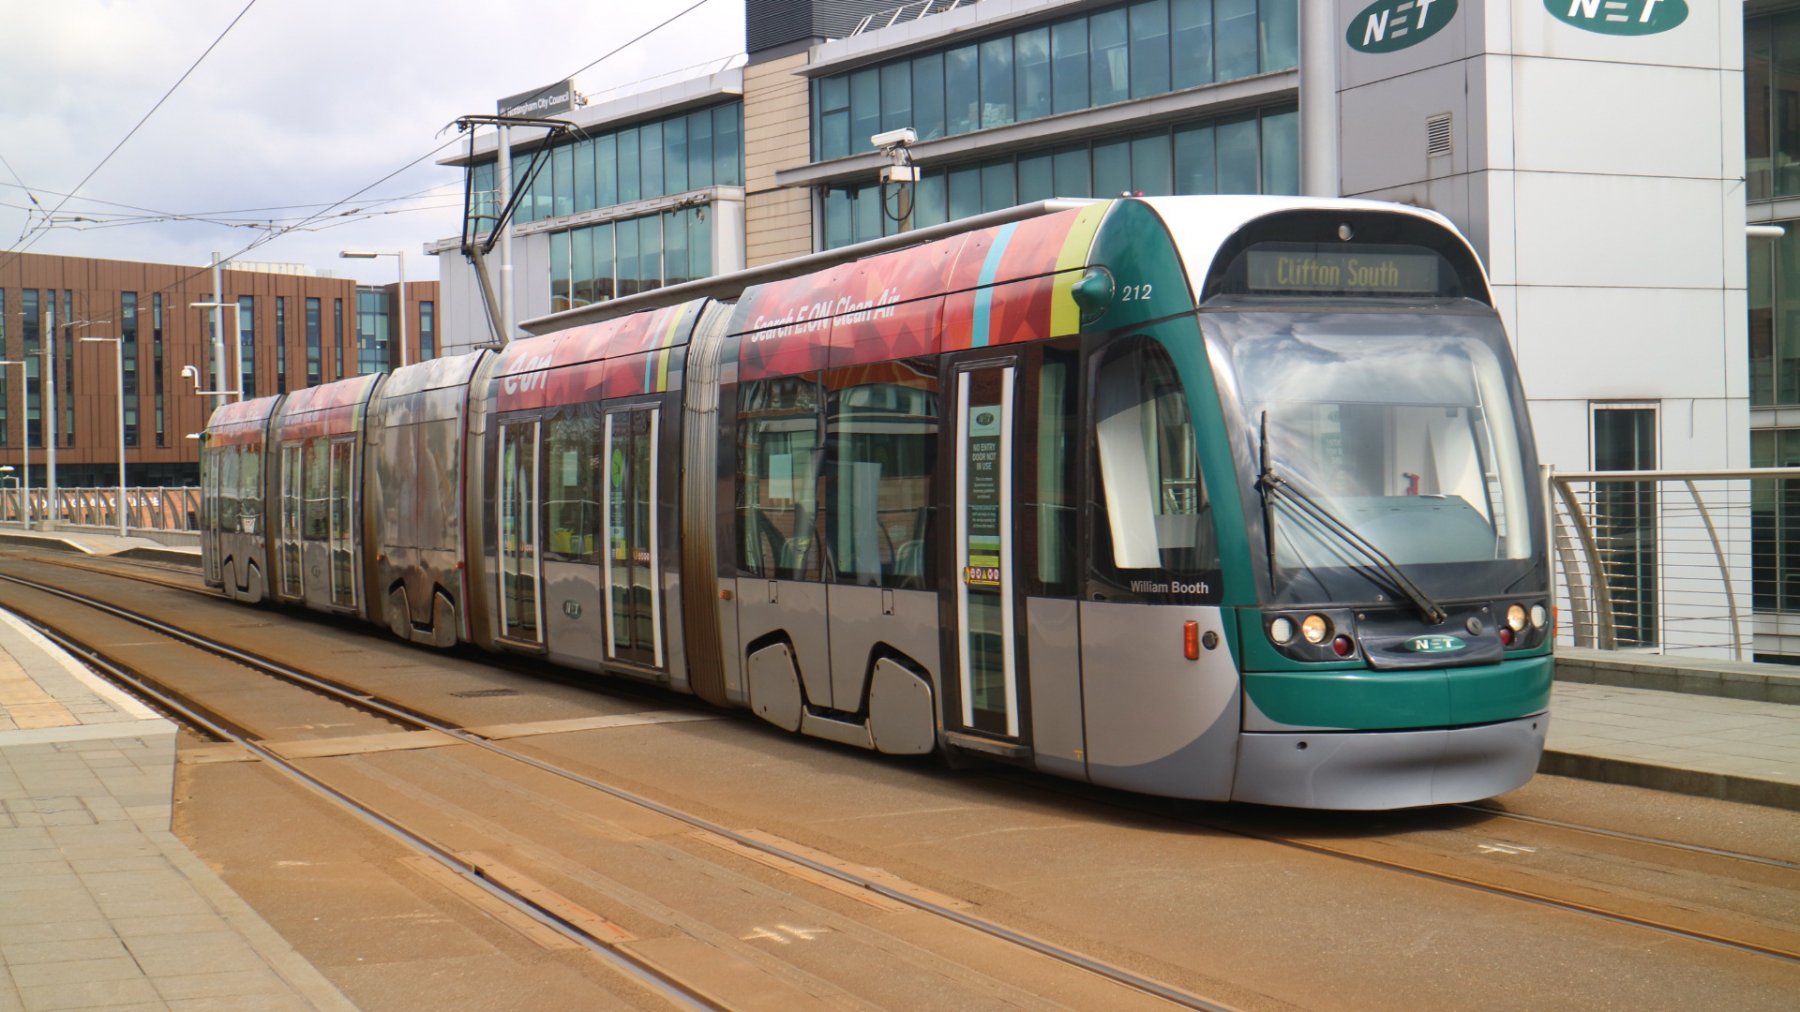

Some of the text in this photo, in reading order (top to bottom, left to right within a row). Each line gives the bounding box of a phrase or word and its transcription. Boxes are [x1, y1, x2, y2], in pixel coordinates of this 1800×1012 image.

[1363, 0, 1436, 46] NET
[538, 98, 549, 109] City
[549, 91, 569, 106] Council
[1278, 256, 1399, 288] Clifton South
[1122, 284, 1153, 302] 212
[751, 287, 901, 343] Search E.ON Clean Air
[1130, 580, 1209, 594] William Booth
[1415, 638, 1455, 650] NET
